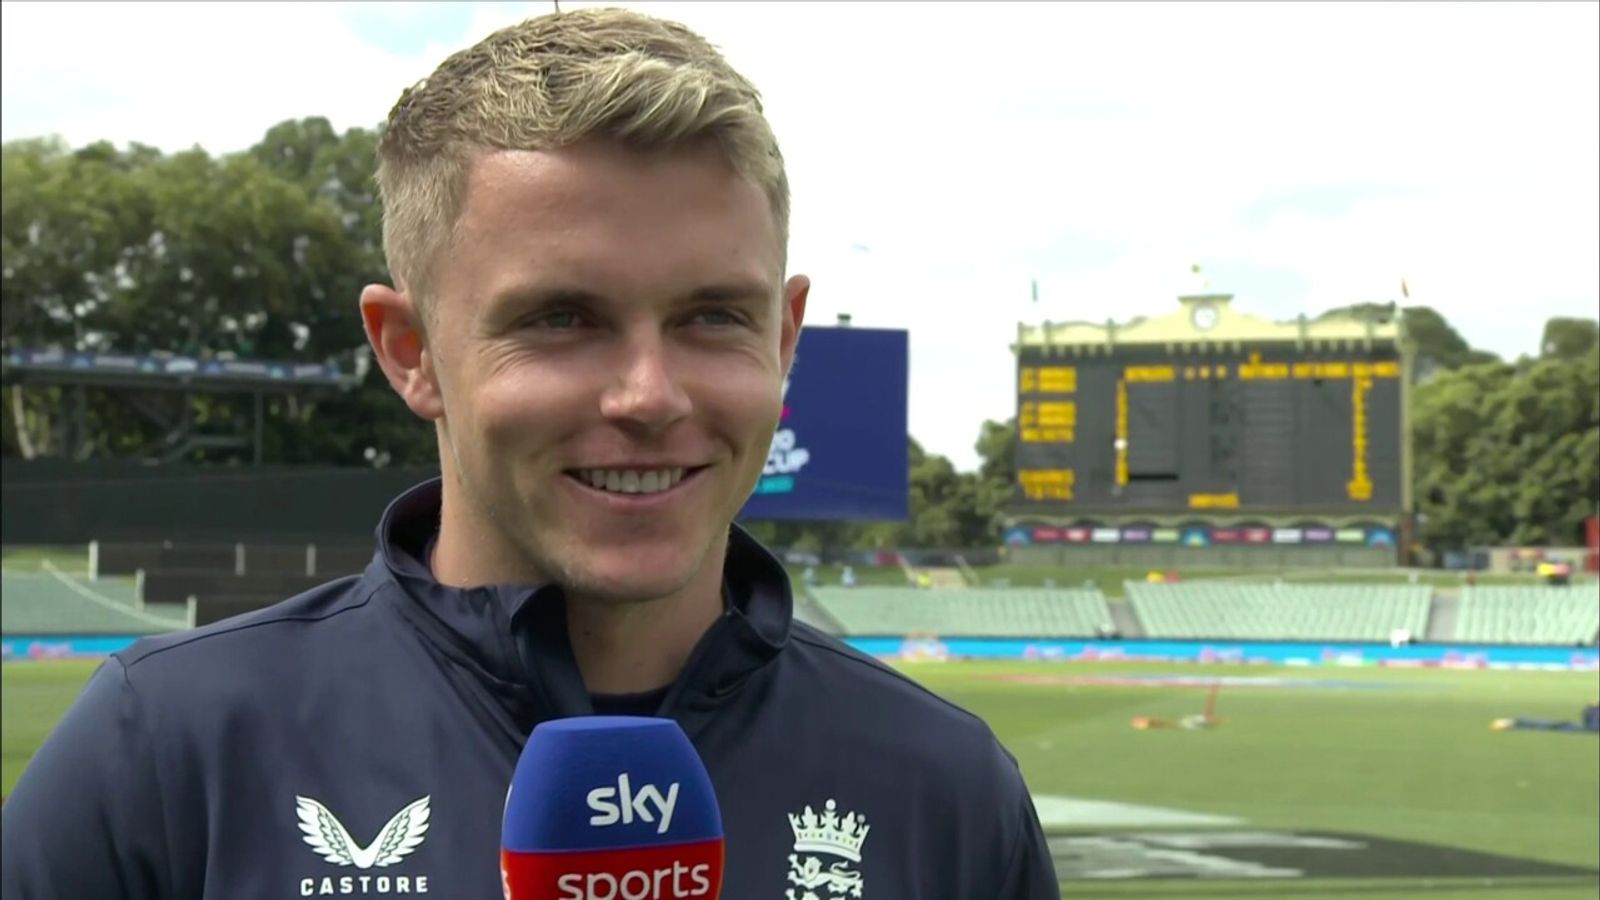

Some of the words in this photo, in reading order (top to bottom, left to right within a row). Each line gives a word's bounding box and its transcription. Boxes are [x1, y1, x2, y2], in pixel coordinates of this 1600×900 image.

[586, 773, 680, 835] sky
[299, 875, 429, 897] CASTORE
[557, 860, 710, 900] sports
